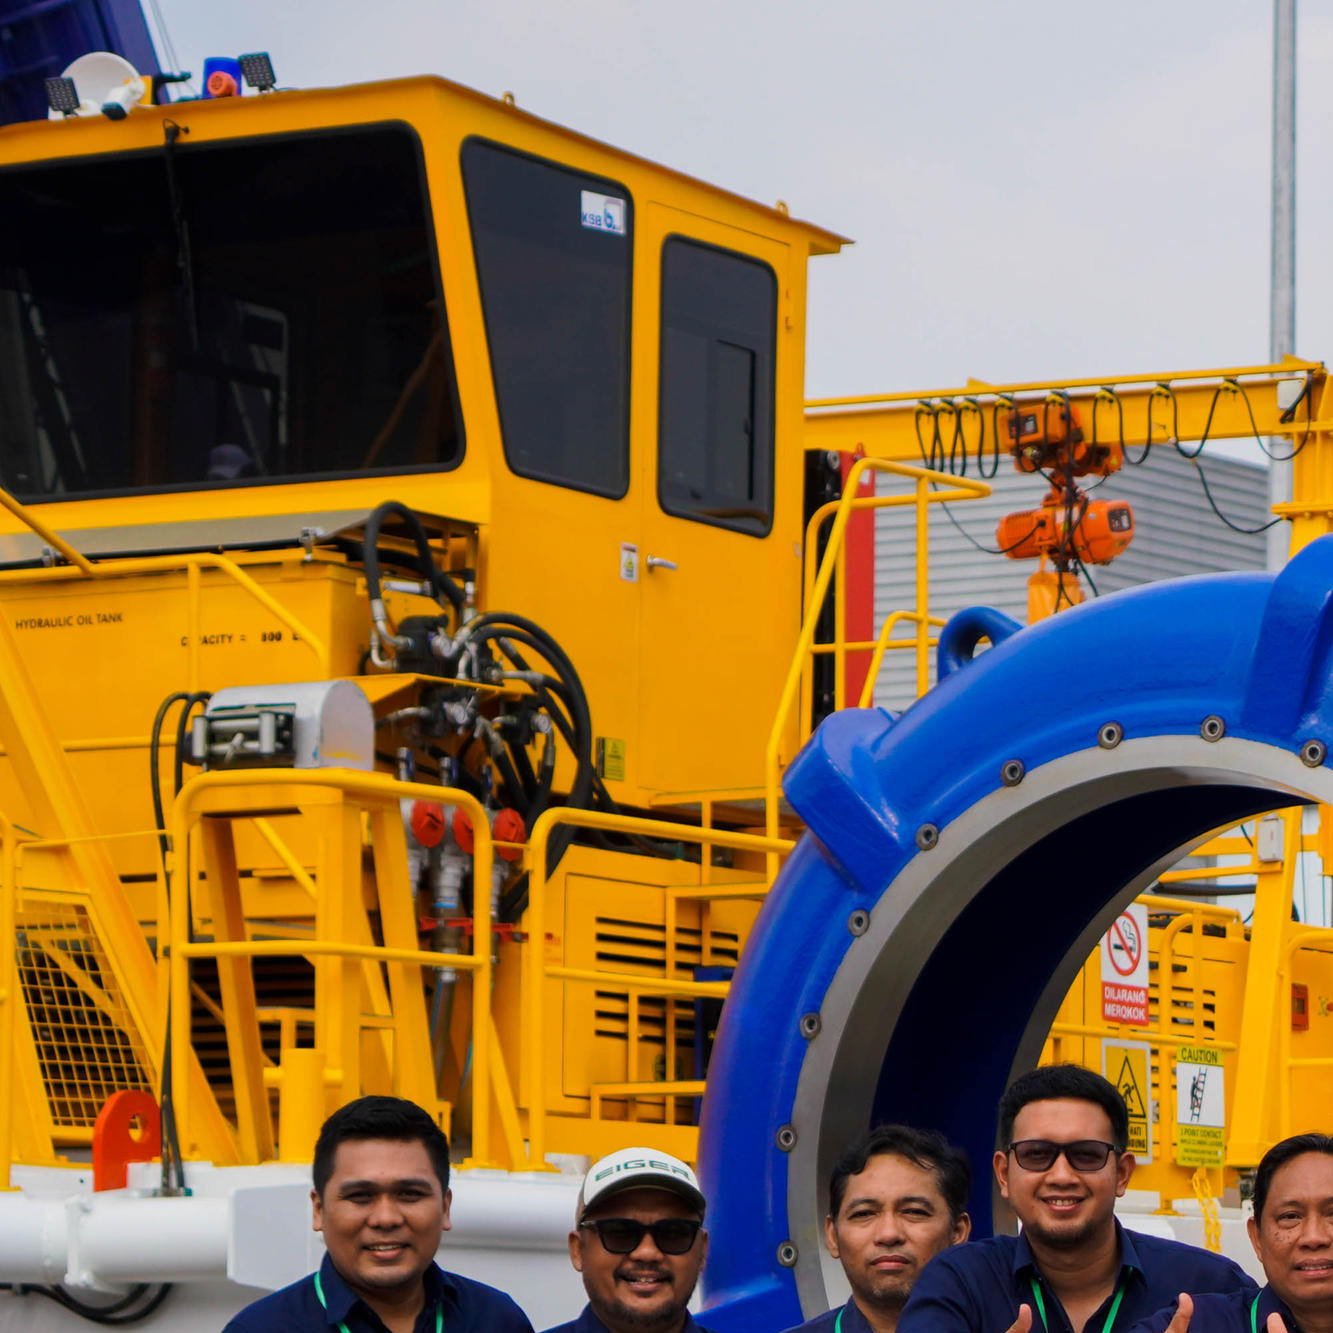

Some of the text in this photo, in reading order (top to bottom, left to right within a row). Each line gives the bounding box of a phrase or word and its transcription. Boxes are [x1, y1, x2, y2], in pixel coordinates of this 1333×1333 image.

[15, 612, 124, 630] HYDRAULIC OIL TANK
[180, 633, 233, 646] CACITY
[1104, 986, 1146, 1004] DILARANG
[1104, 1003, 1146, 1021] MEROKOK
[1181, 1047, 1218, 1063] CAUTION
[595, 1159, 690, 1181] EIGER
